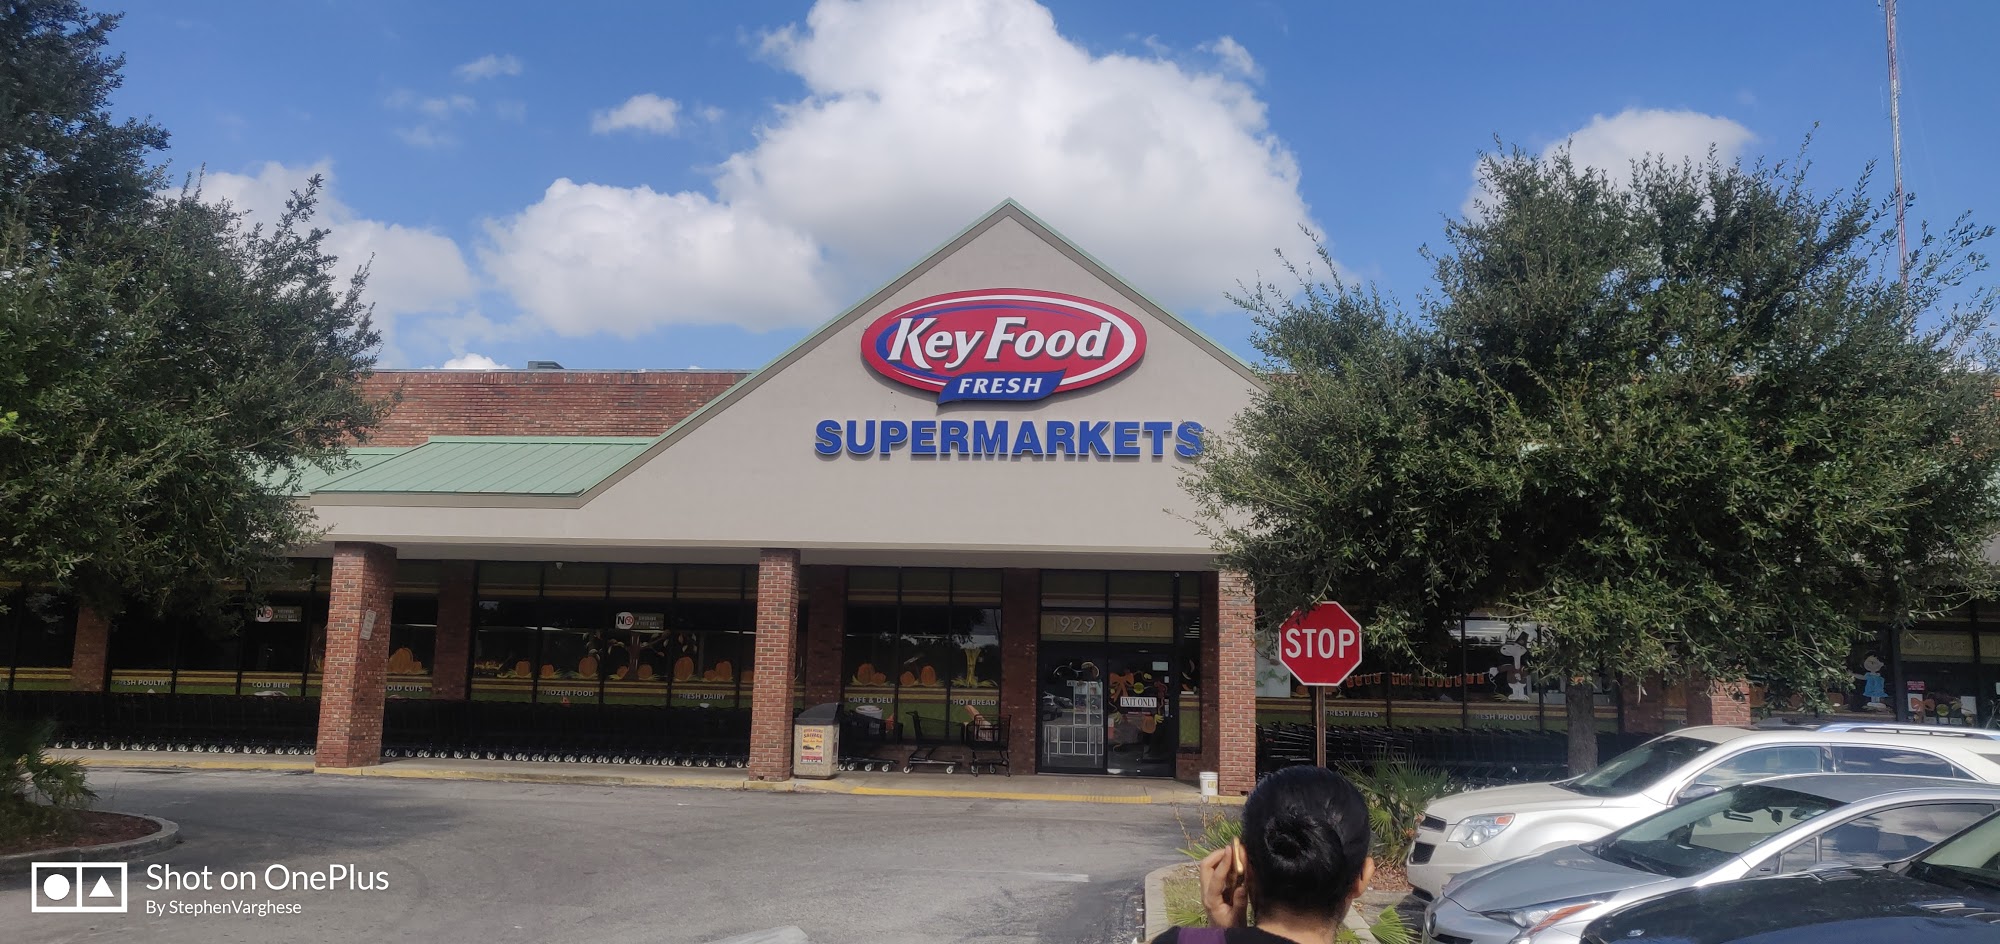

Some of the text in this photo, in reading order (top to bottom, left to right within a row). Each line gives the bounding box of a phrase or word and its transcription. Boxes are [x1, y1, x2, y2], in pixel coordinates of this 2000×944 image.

[887, 315, 1112, 370] Key Food
[957, 377, 1043, 395] FRESH
[814, 419, 1204, 458] SUPERMARKETS
[1285, 628, 1356, 659] STOP
[387, 684, 402, 692] OLD
[543, 689, 594, 697] FROZEN FOOD
[679, 692, 701, 700] FRESH
[1121, 697, 1156, 707] EXIT ONLY
[1351, 710, 1379, 718] MEATS
